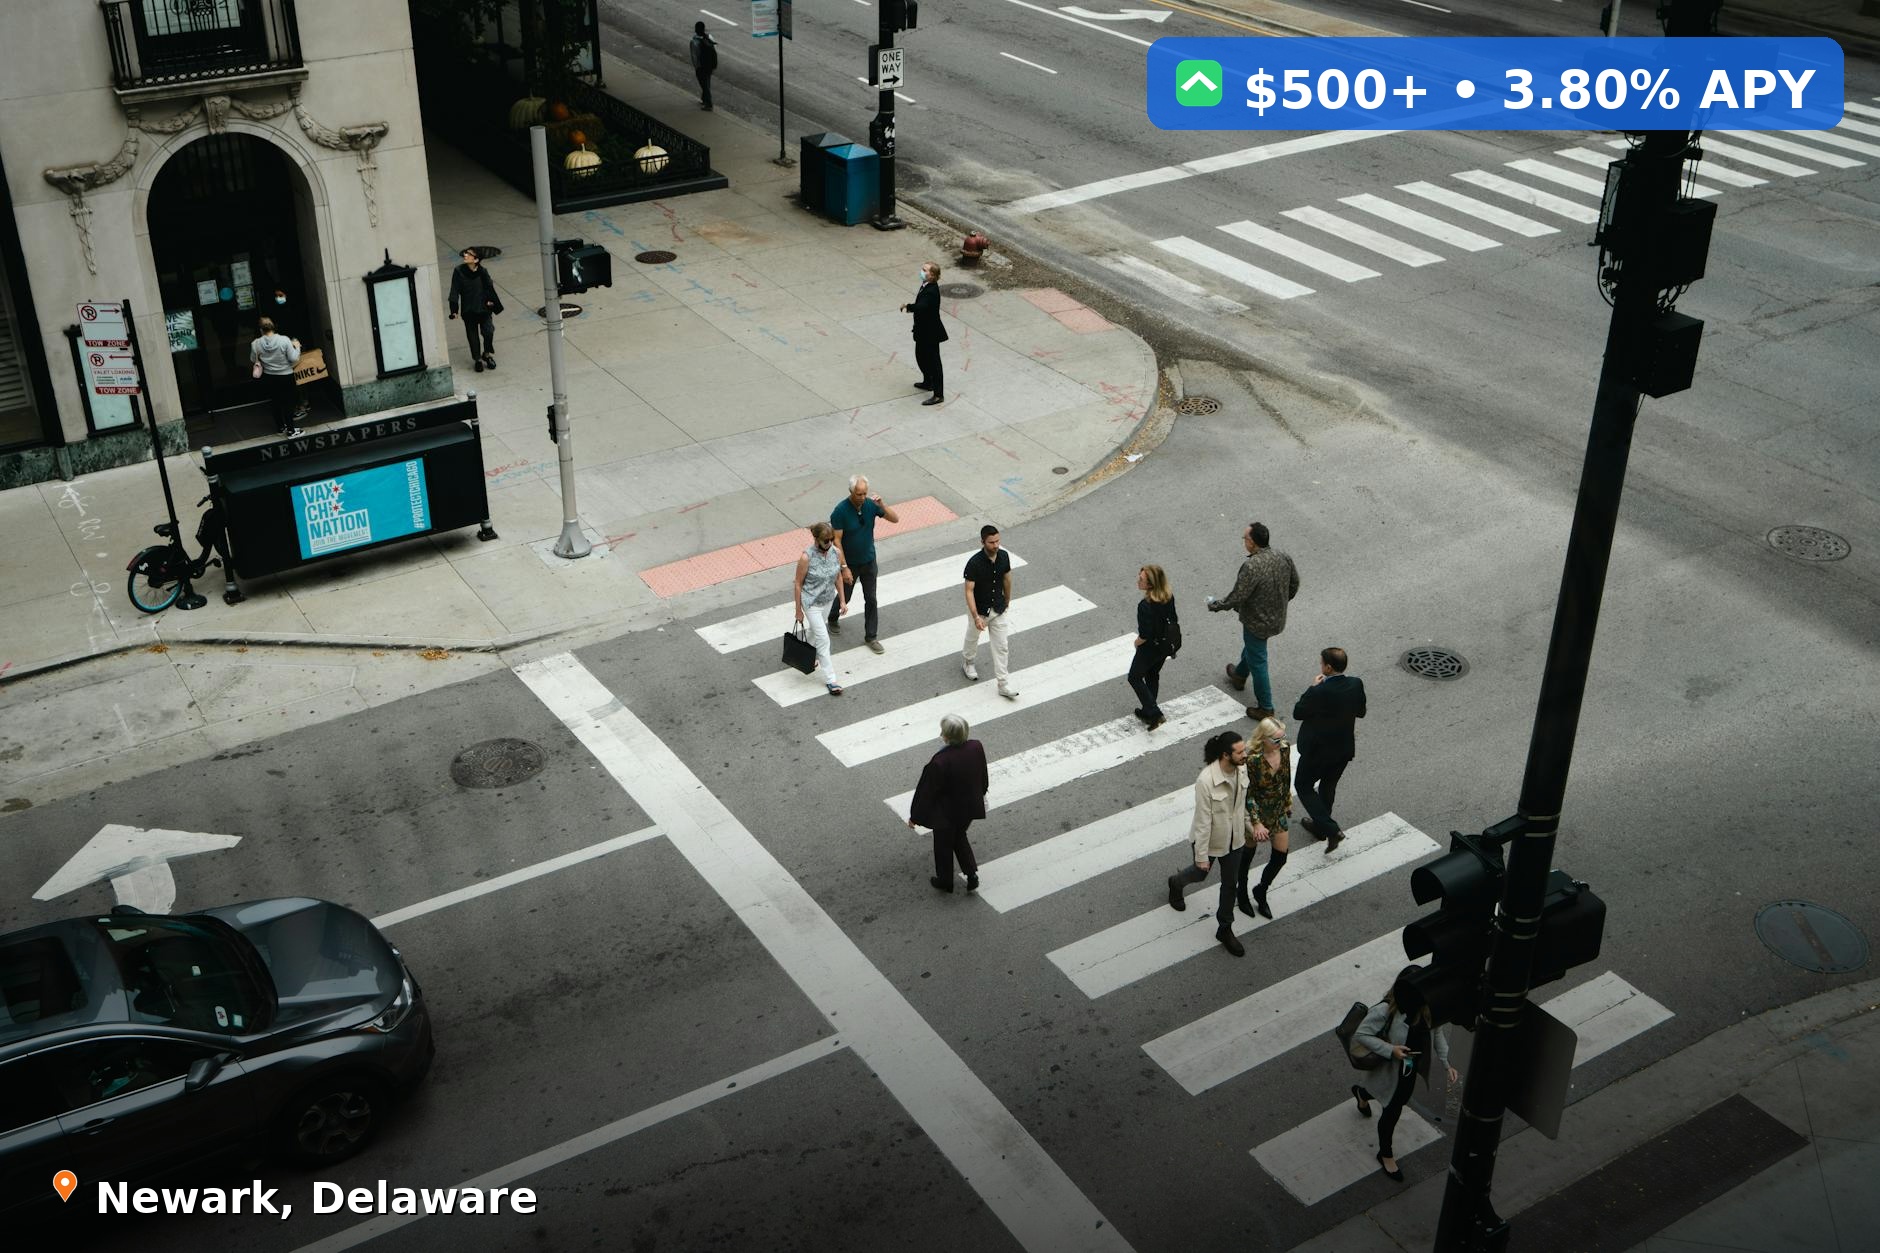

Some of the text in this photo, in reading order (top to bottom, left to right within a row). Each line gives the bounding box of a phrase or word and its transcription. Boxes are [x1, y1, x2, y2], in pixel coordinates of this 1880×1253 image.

[882, 51, 901, 62] ONE
[881, 63, 901, 74] WAY
[294, 366, 316, 381] NIKE
[260, 417, 418, 461] NEWSPAPERS
[304, 482, 335, 504] VAX
[406, 460, 425, 528] #PROTECTCHICAGO
[309, 511, 368, 539] NATION
[327, 534, 337, 543] THE
